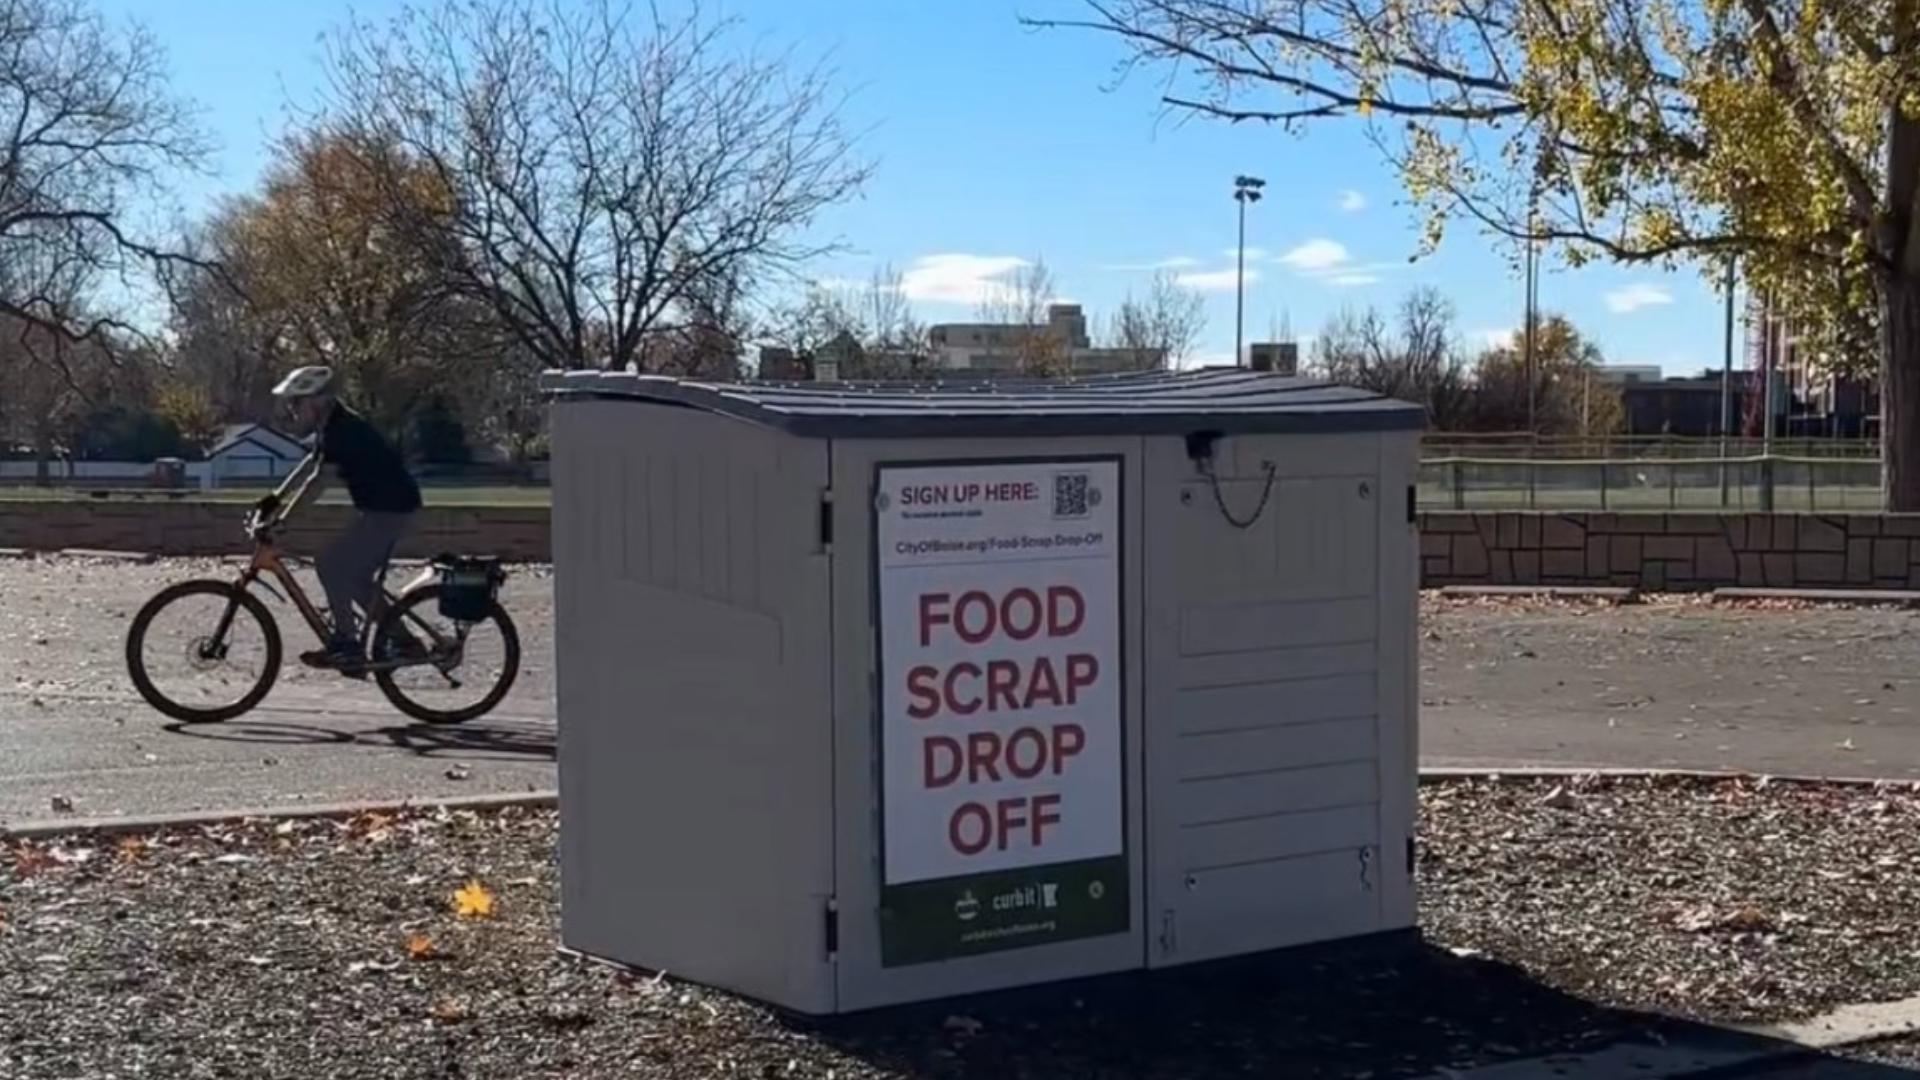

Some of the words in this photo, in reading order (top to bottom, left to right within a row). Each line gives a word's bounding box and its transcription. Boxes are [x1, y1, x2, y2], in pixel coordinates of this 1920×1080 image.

[901, 486, 948, 504] SIGN
[954, 484, 979, 503] UP
[985, 482, 1039, 502] HERE:
[919, 585, 1085, 647] FOOD
[906, 653, 1098, 719] SCRAP
[923, 723, 1085, 789] DROP
[949, 794, 1061, 855] OFF
